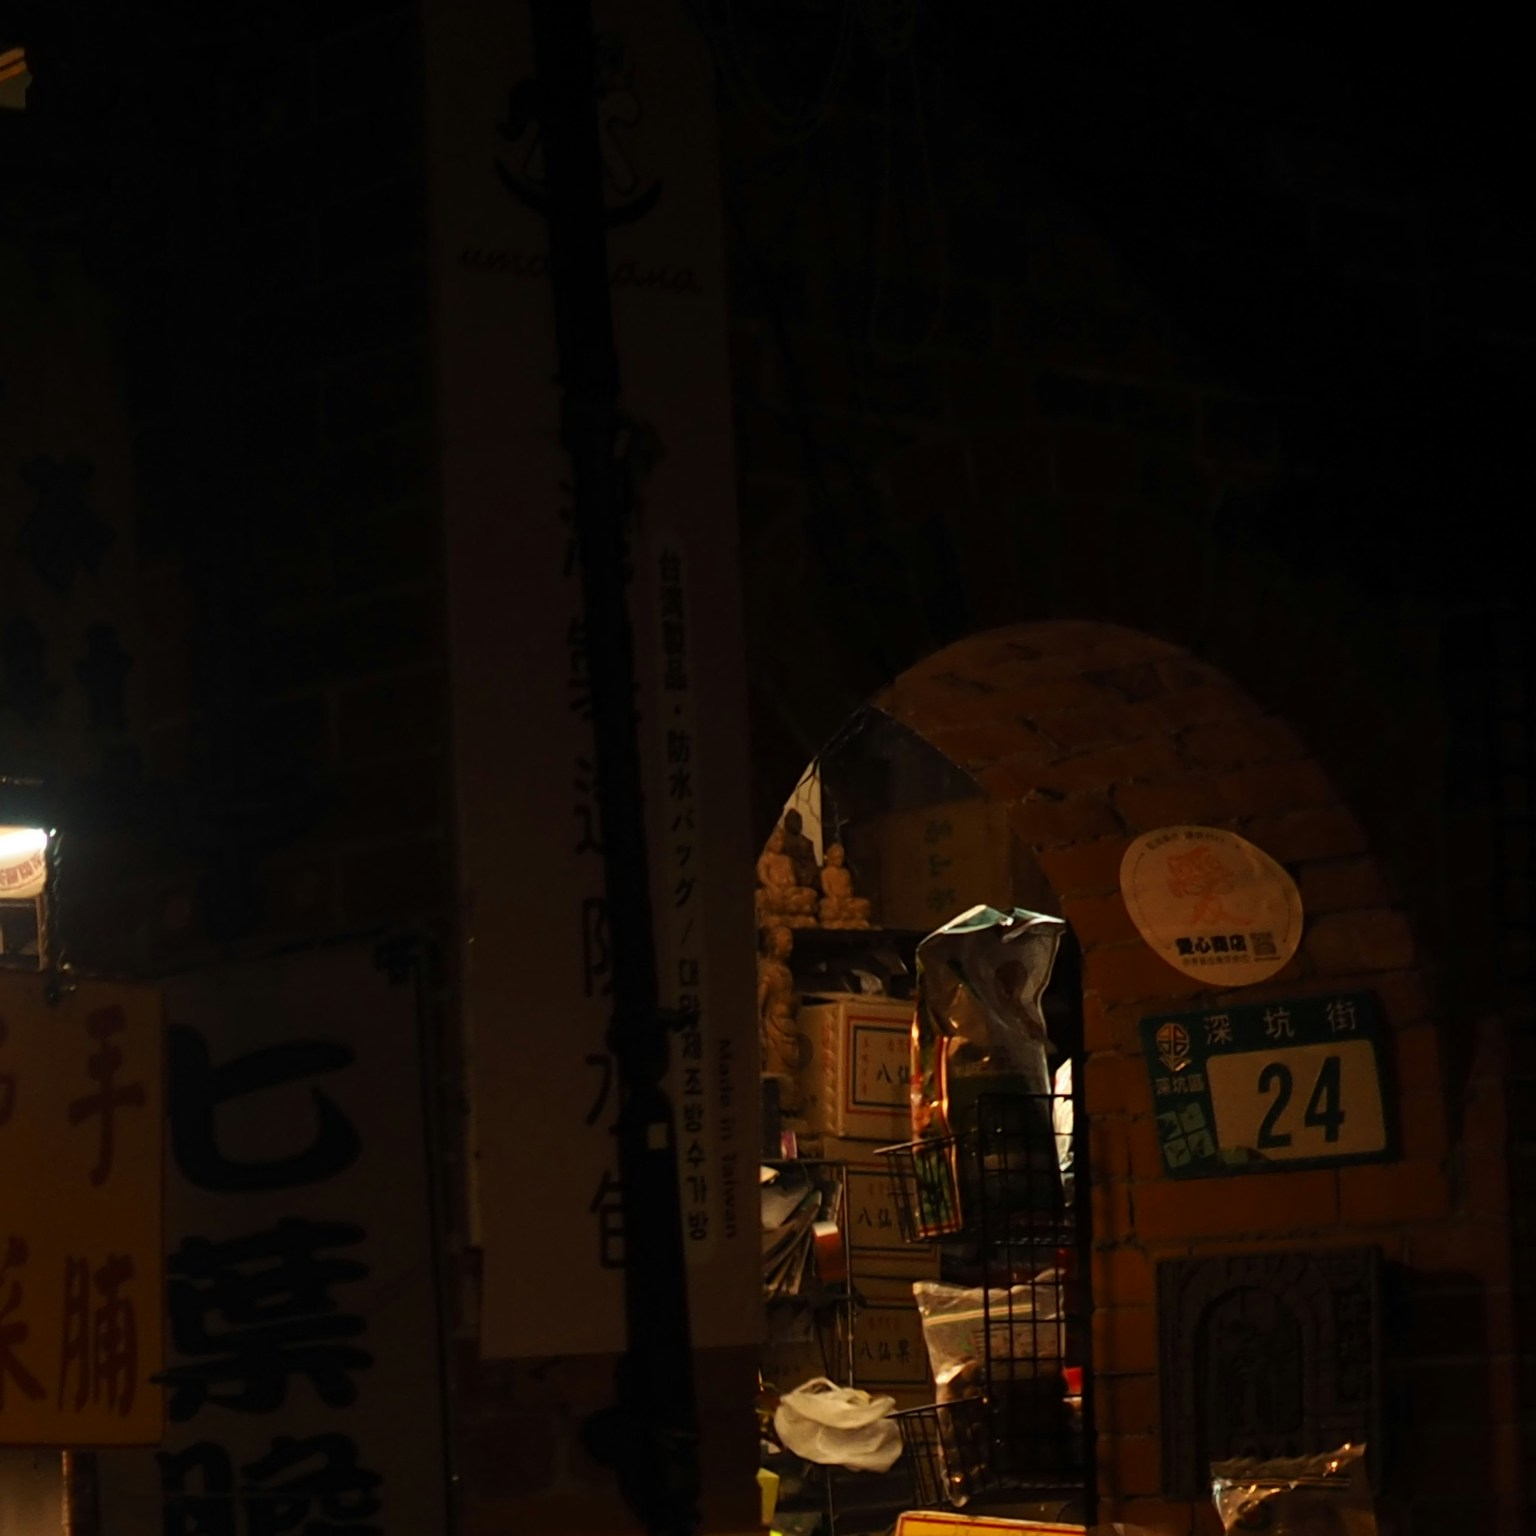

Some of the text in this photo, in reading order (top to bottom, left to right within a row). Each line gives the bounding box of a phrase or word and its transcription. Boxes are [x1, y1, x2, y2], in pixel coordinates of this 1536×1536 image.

[1202, 1000, 1359, 1045] 深坑街
[1153, 1075, 1206, 1096] 深坑區
[1256, 1055, 1346, 1149] 24
